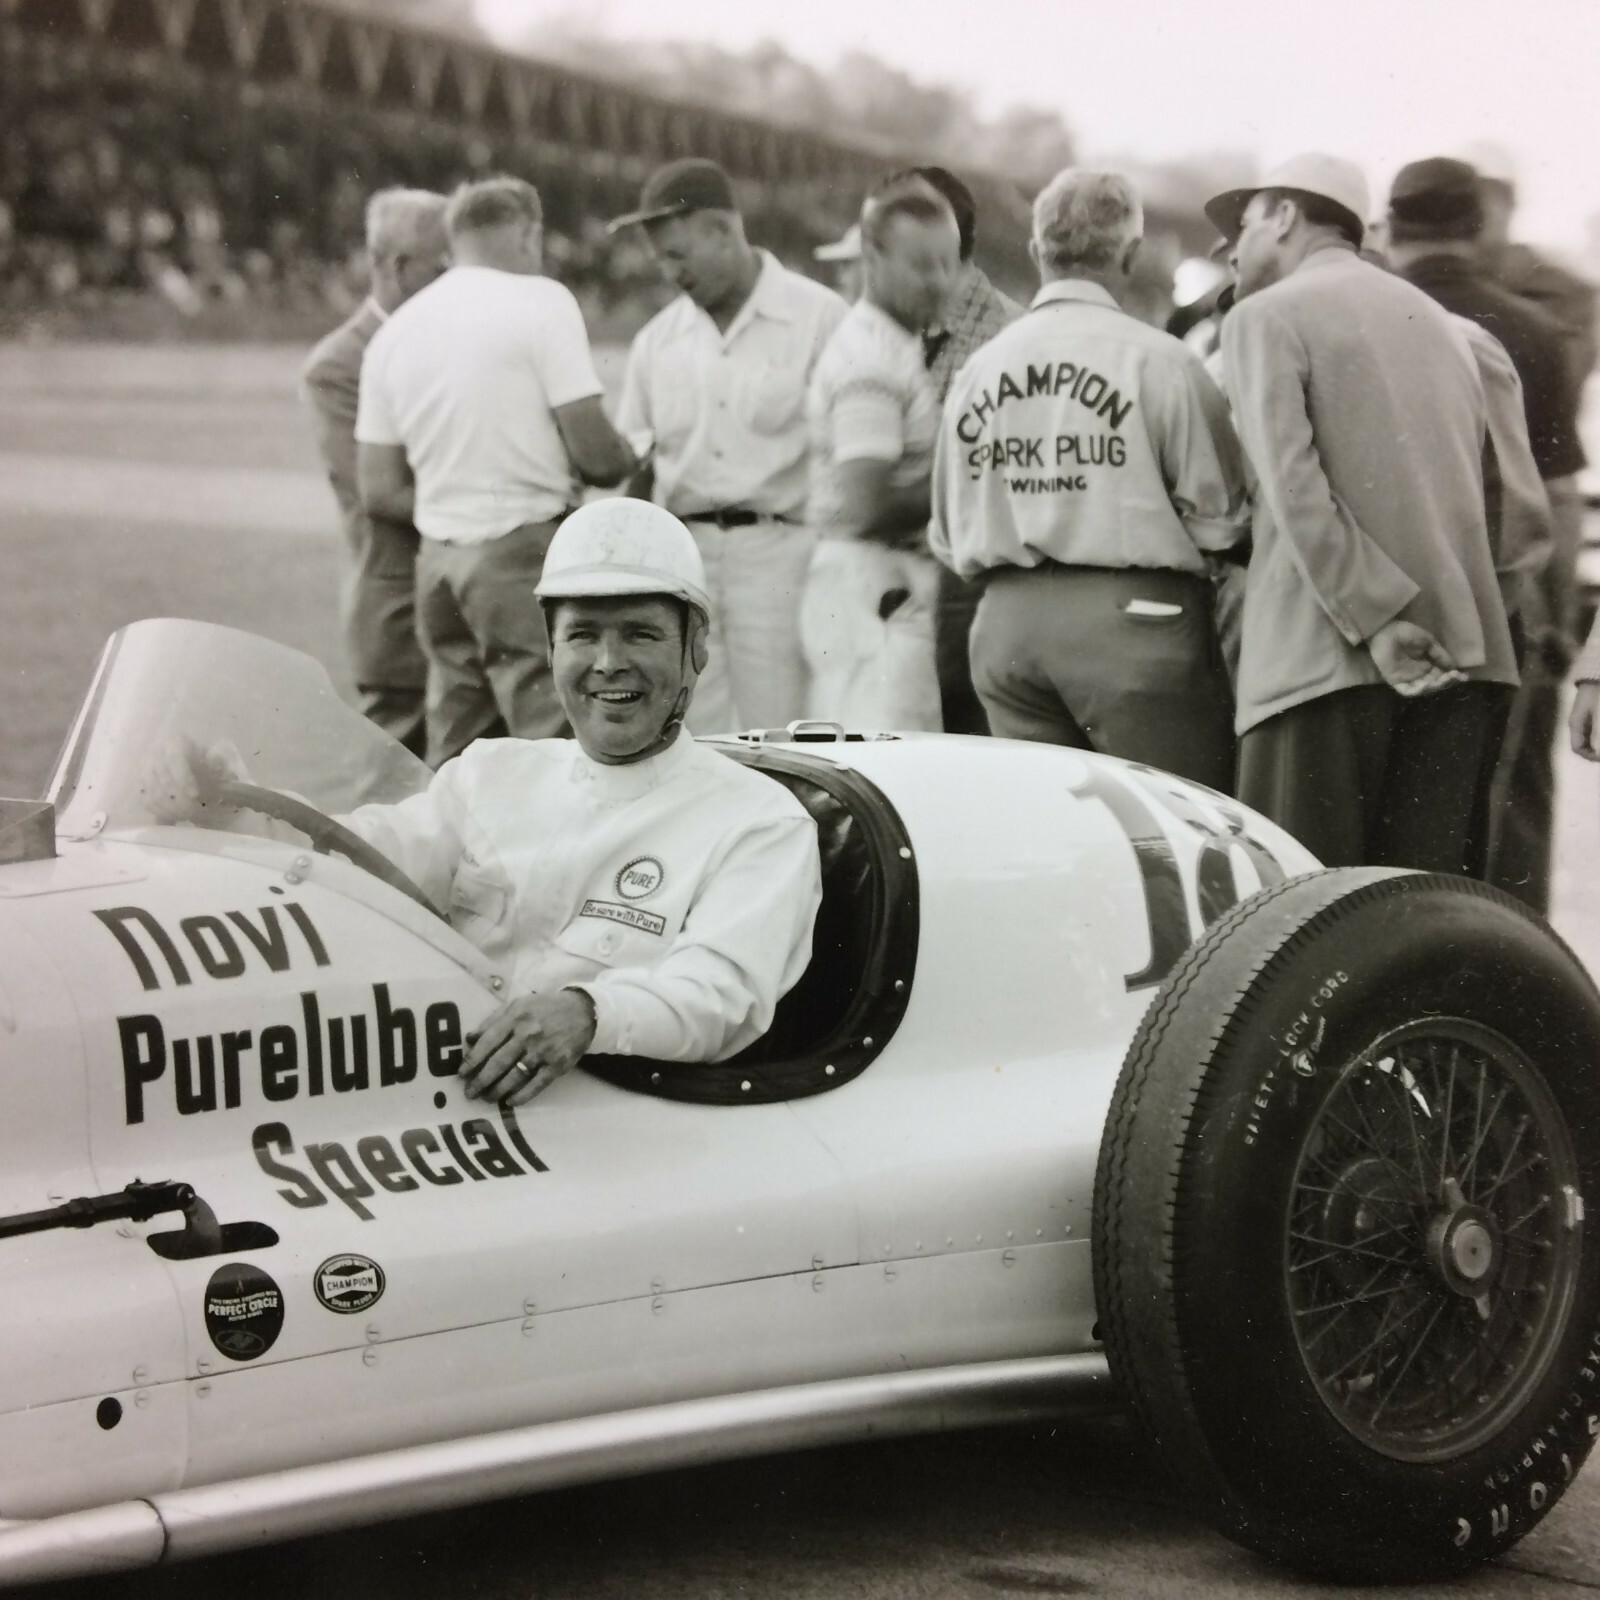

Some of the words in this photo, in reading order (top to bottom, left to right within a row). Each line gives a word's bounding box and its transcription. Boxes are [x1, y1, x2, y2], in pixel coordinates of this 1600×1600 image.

[957, 363, 1133, 443] CHAMPION
[968, 437, 1044, 480] SPARK
[1056, 434, 1126, 467] PLUG
[1004, 475, 1088, 494] WINING
[623, 871, 656, 889] PURE
[584, 903, 597, 914] Be
[597, 906, 616, 917] sure
[616, 910, 636, 923] with
[636, 914, 661, 931] Pure
[116, 982, 464, 1126] Purelube
[251, 1091, 550, 1221] Special
[327, 1276, 373, 1292] CHAMPION
[208, 1303, 247, 1316] PERFECT
[248, 1297, 278, 1312] CIRCLE
